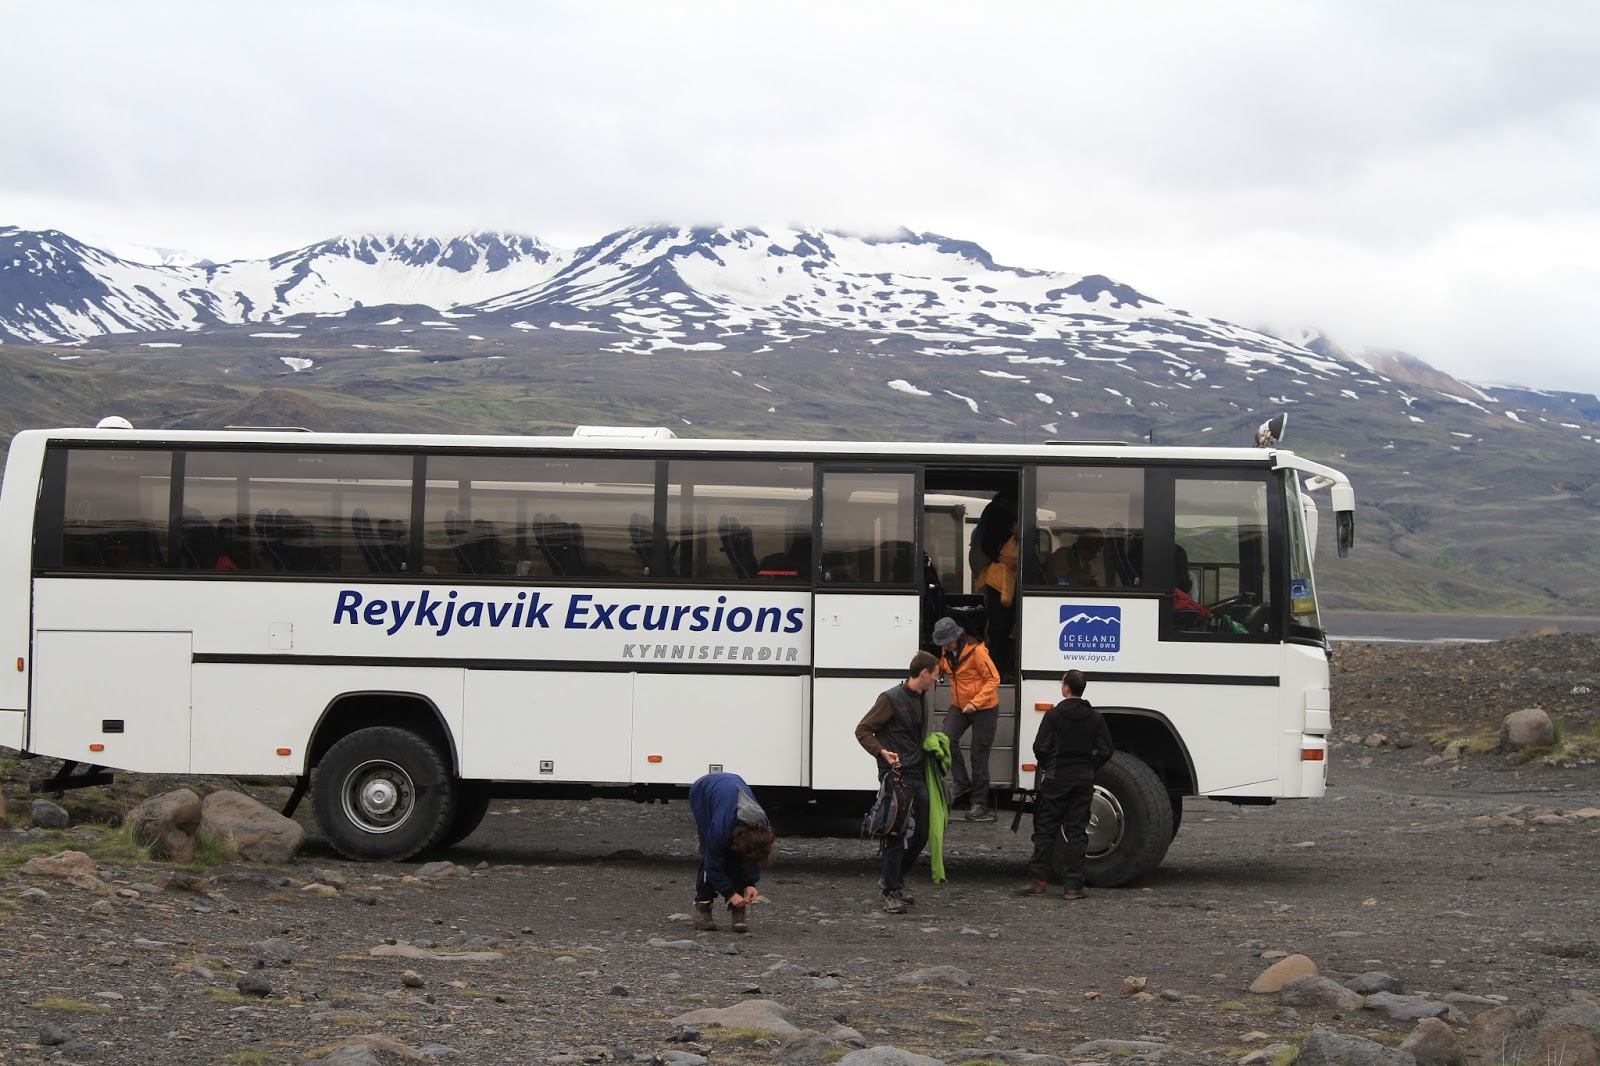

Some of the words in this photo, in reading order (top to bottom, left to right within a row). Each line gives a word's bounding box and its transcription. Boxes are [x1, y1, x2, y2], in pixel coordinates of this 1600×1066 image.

[333, 590, 553, 636] Reykjavik
[564, 594, 804, 633] Excursions
[622, 643, 798, 662] KYNNISFERÐIR
[1064, 653, 1115, 662] www.ioyo.is
